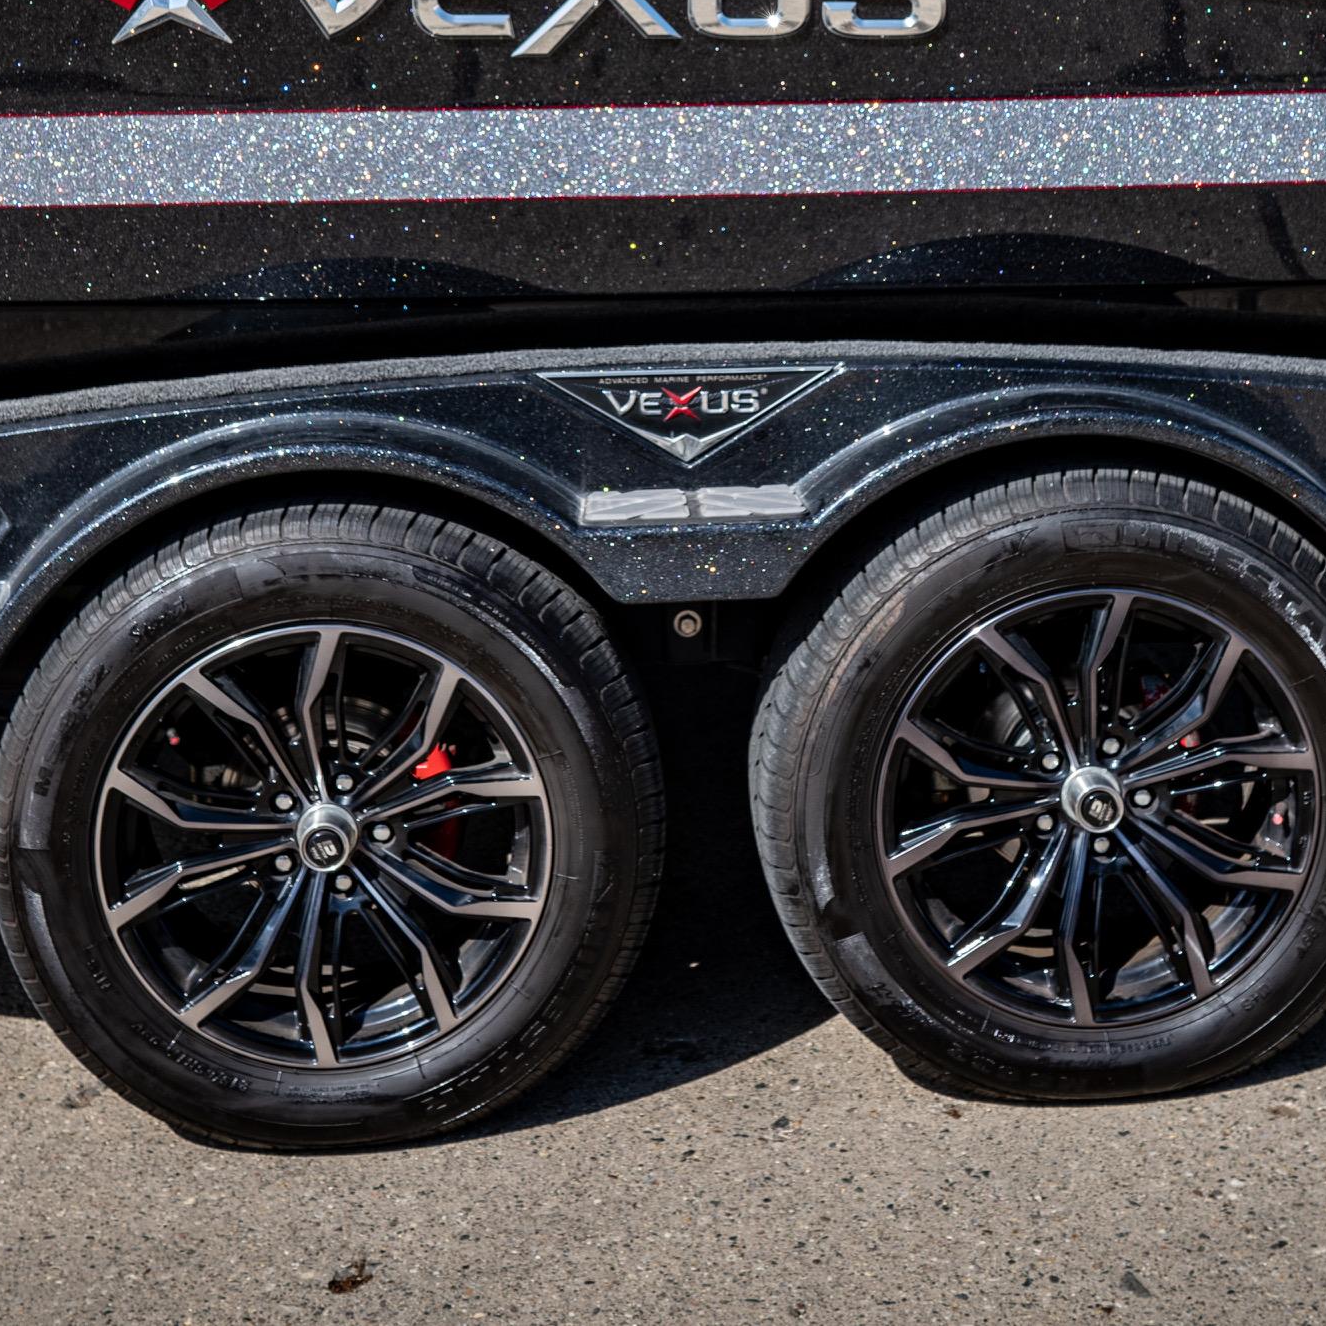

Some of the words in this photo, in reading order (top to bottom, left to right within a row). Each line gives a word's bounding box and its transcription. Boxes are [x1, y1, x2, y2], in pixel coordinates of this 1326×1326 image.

[598, 377, 649, 385] ADVANCED
[653, 376, 690, 384] MARINE
[601, 385, 760, 423] VEXUS
